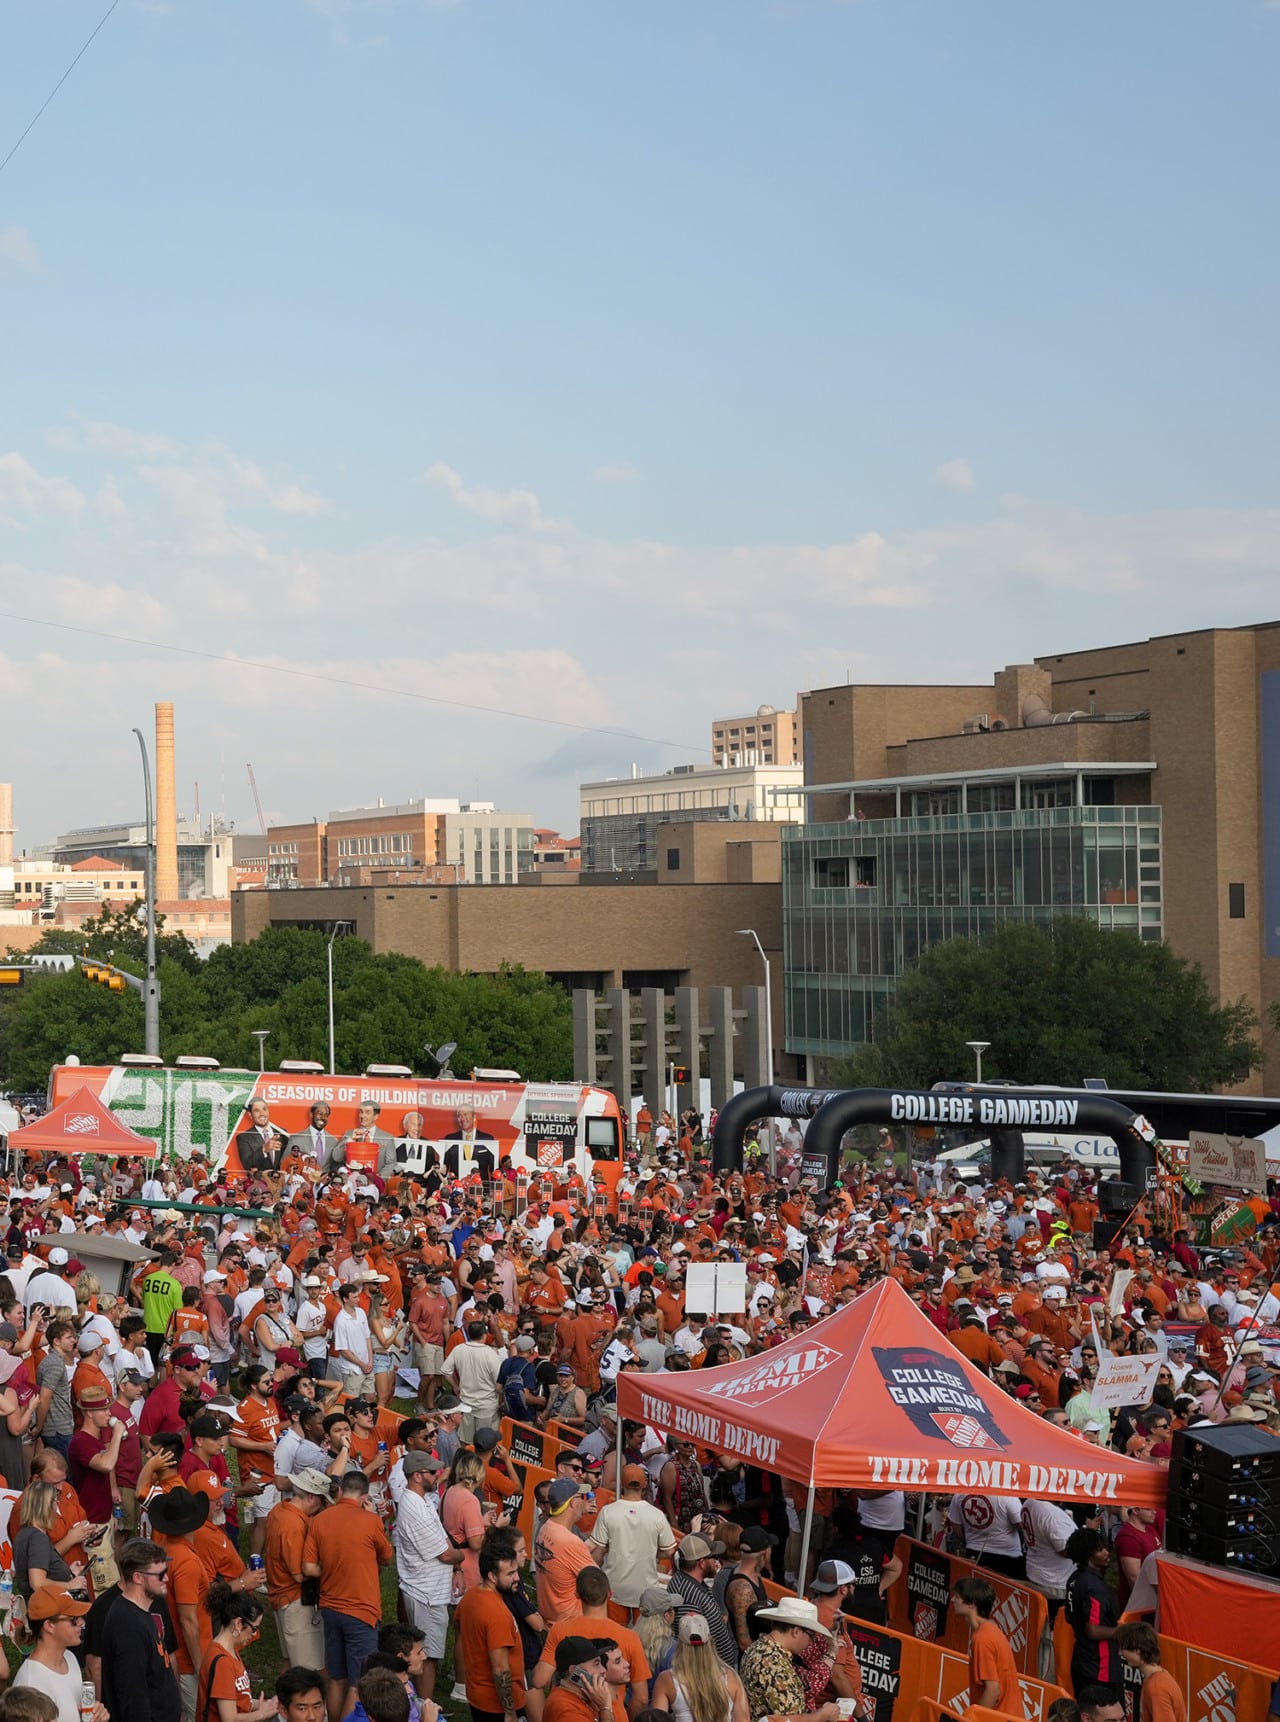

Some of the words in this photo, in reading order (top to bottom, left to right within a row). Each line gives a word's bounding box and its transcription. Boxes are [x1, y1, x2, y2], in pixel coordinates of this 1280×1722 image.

[268, 1085, 334, 1101] SEASONS
[338, 1087, 356, 1102] OF
[360, 1089, 427, 1105] BUILDING
[431, 1092, 500, 1108] GAMEDAY
[531, 1112, 571, 1122] COLLEGE
[891, 1094, 973, 1123] COLLEGE
[980, 1098, 1079, 1126] GAMEDAY
[524, 1122, 577, 1136] GAMEDAY
[538, 1141, 563, 1165] HOME
[1074, 1139, 1120, 1157] Cla
[144, 1278, 171, 1296] 360
[710, 1347, 832, 1393] HOME
[891, 1368, 966, 1391] COLLEGE
[1097, 1374, 1139, 1387] SLAMMA
[725, 1372, 806, 1398] DEPOT
[888, 1386, 986, 1414] GAMEDAY
[260, 1414, 280, 1428] TEXAS
[641, 1393, 672, 1426] THE
[674, 1405, 721, 1446] HOME
[723, 1422, 783, 1466] DEPOT
[944, 1416, 960, 1431] THE
[951, 1415, 981, 1447] HOME
[269, 1427, 277, 1443] 1
[515, 1439, 540, 1458] COLLEGE
[868, 1456, 929, 1485] THE
[936, 1459, 1020, 1489] HOME
[1028, 1465, 1125, 1499] DEPOT
[860, 1566, 874, 1577] CSG
[914, 1562, 945, 1586] COLLEGE
[908, 1575, 950, 1606] GAMEDAY
[850, 1629, 881, 1648] ESPN
[853, 1645, 892, 1671] LLEGE
[861, 1668, 899, 1695] EDAY
[1196, 1671, 1236, 1708] THE
